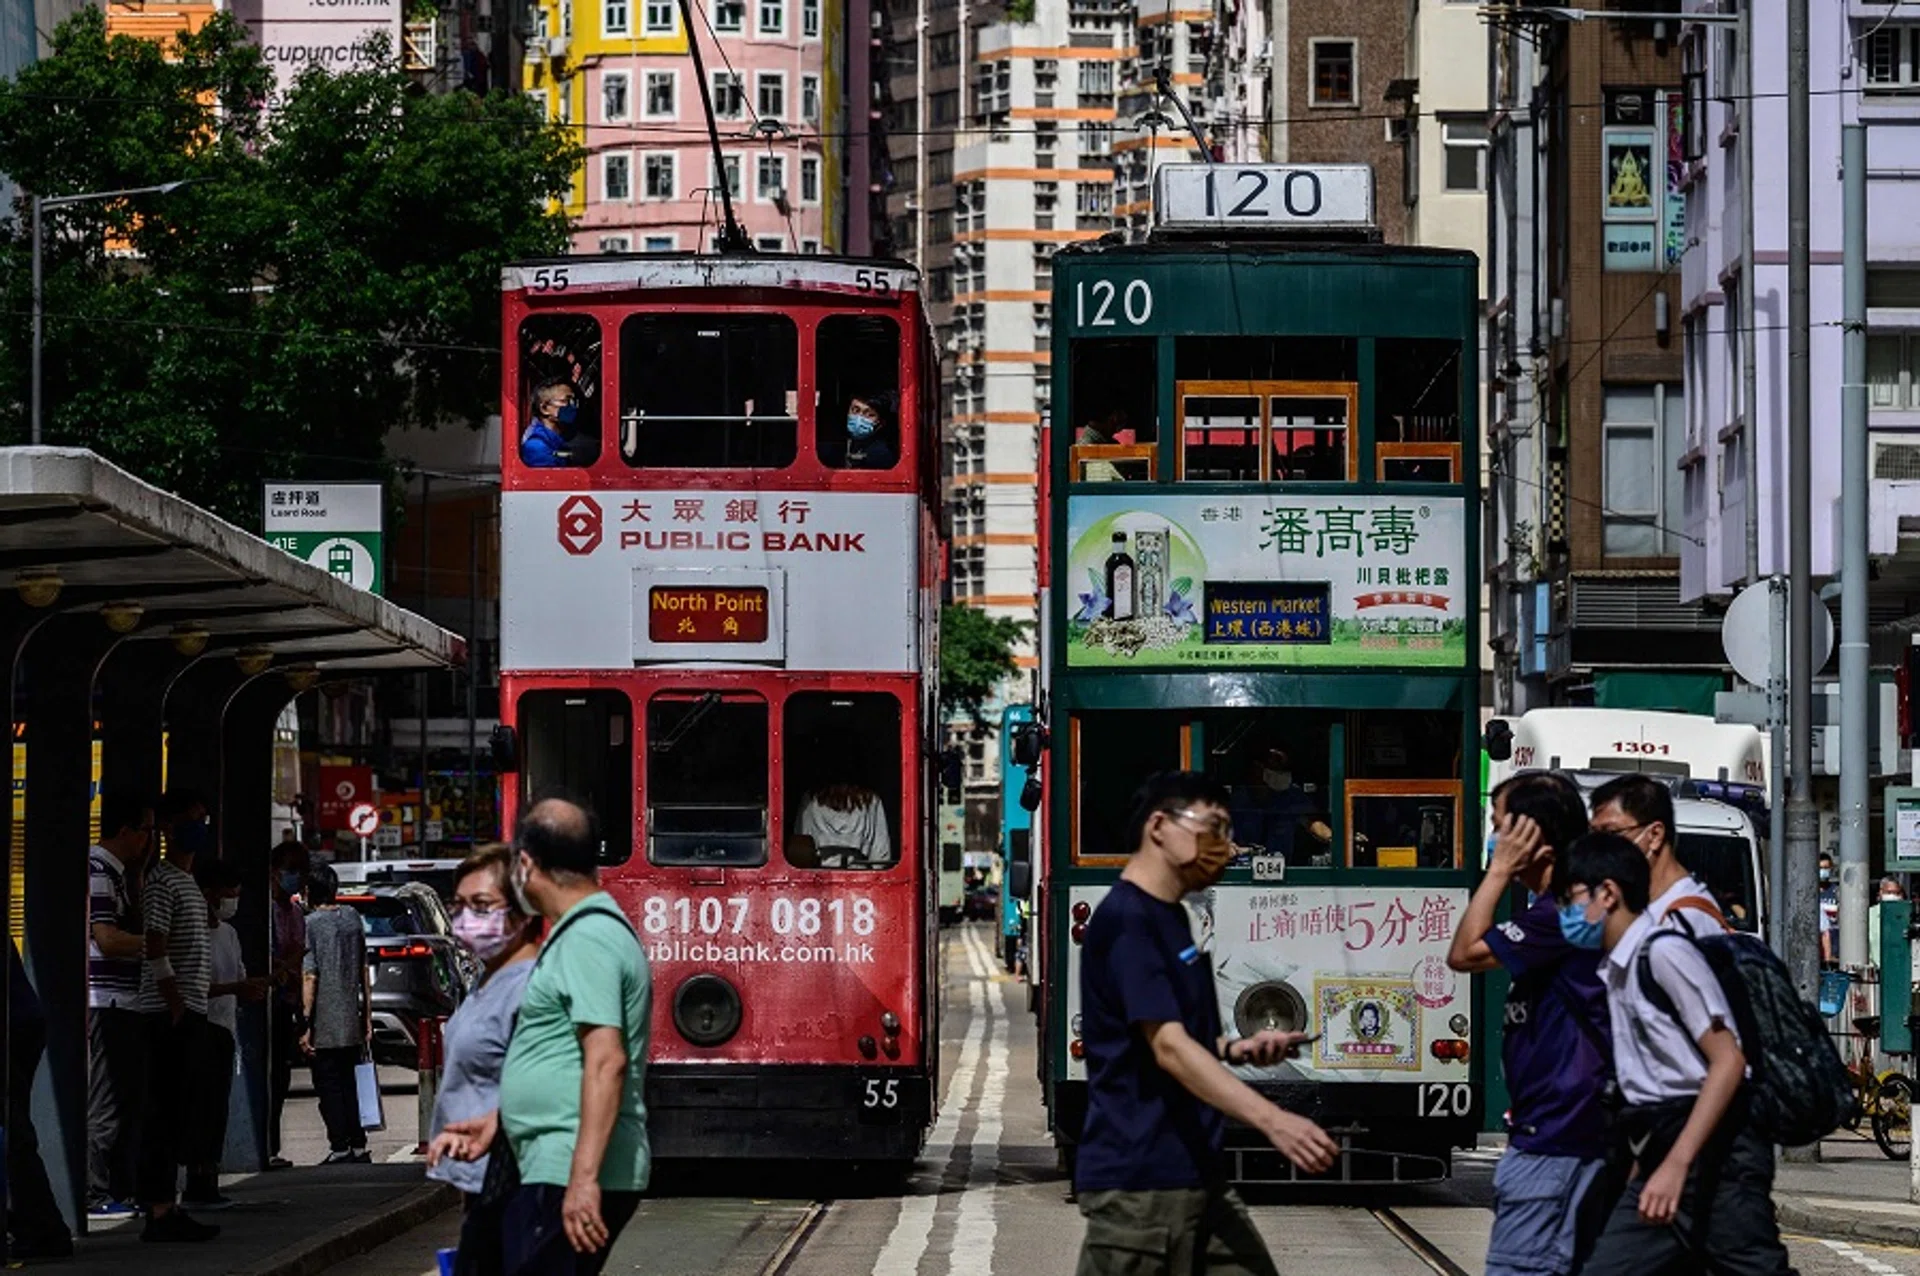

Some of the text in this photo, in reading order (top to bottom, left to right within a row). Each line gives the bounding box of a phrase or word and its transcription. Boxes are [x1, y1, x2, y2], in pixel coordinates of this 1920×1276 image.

[1205, 170, 1322, 217] 120
[533, 269, 569, 292] 55
[855, 269, 890, 295] 55
[1075, 279, 1153, 327] 120
[301, 508, 327, 517] Road
[621, 498, 811, 524] 大眾銀行
[1201, 506, 1242, 521] 香港
[620, 531, 866, 552] PUBLIC BANK
[1357, 567, 1449, 586] 川貝枇杷露
[652, 592, 763, 612] North Point
[1210, 597, 1321, 614] Western Market
[677, 616, 740, 635] 北角
[1612, 741, 1671, 755] 1301
[643, 897, 875, 936] 8107 0818
[863, 1079, 900, 1108] 55
[1417, 1083, 1472, 1118] 120
